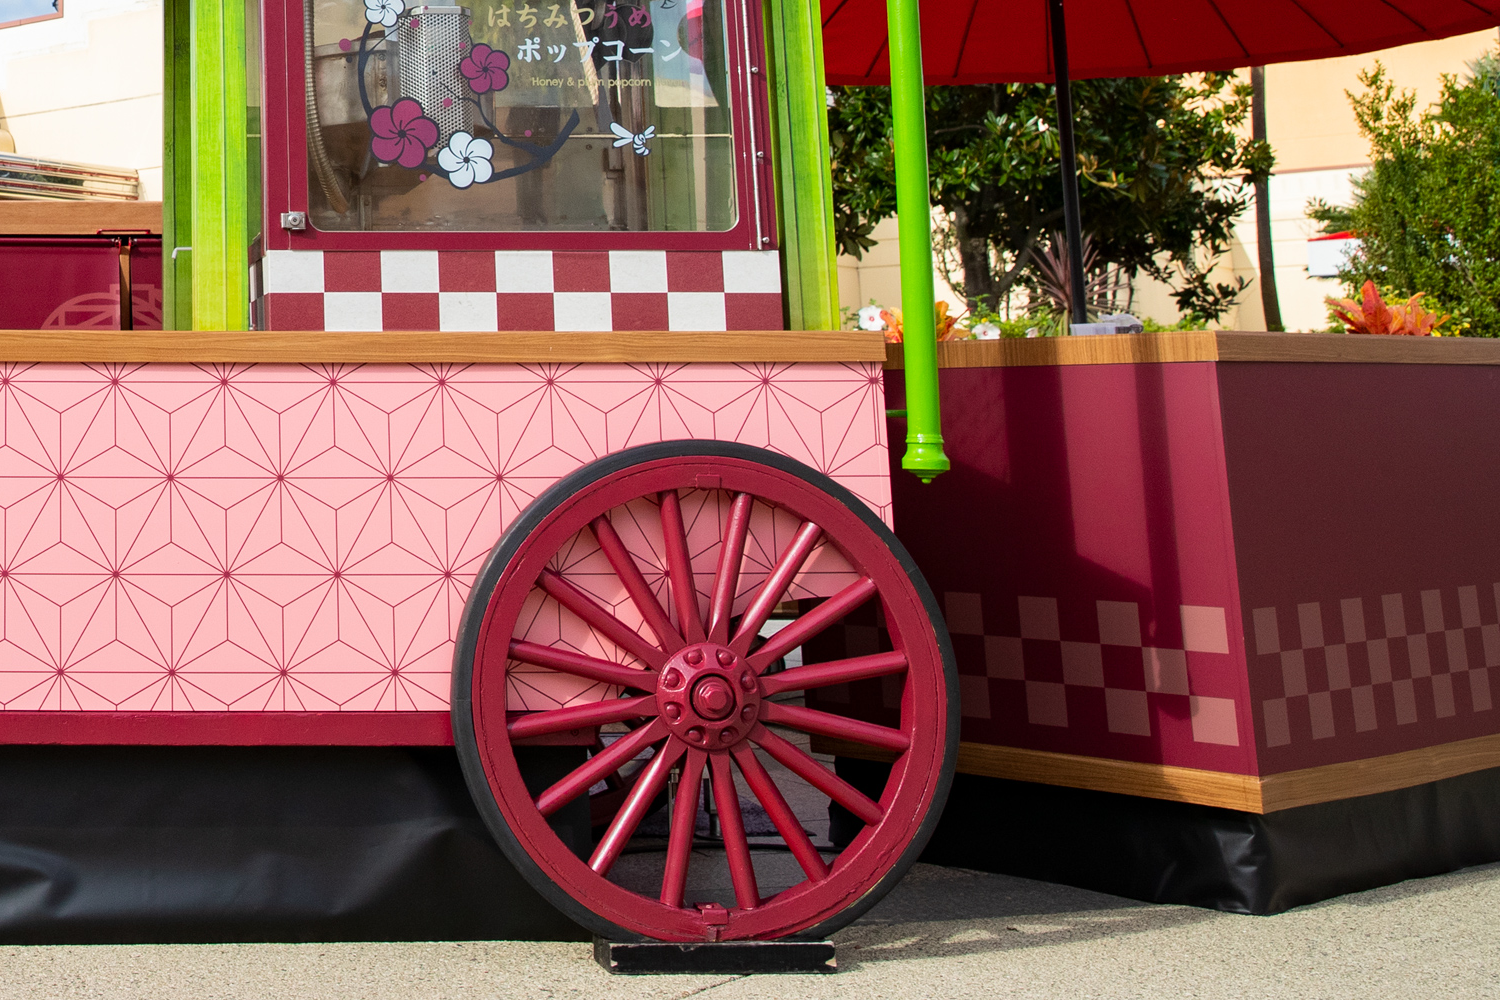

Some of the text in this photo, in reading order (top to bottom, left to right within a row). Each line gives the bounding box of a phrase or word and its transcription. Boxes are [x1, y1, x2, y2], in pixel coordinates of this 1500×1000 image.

[488, 4, 651, 28] はちみつうめ
[517, 37, 681, 62] ポップコーン
[532, 77, 562, 87] Honey
[567, 78, 574, 86] &
[608, 79, 651, 88] popcorn
